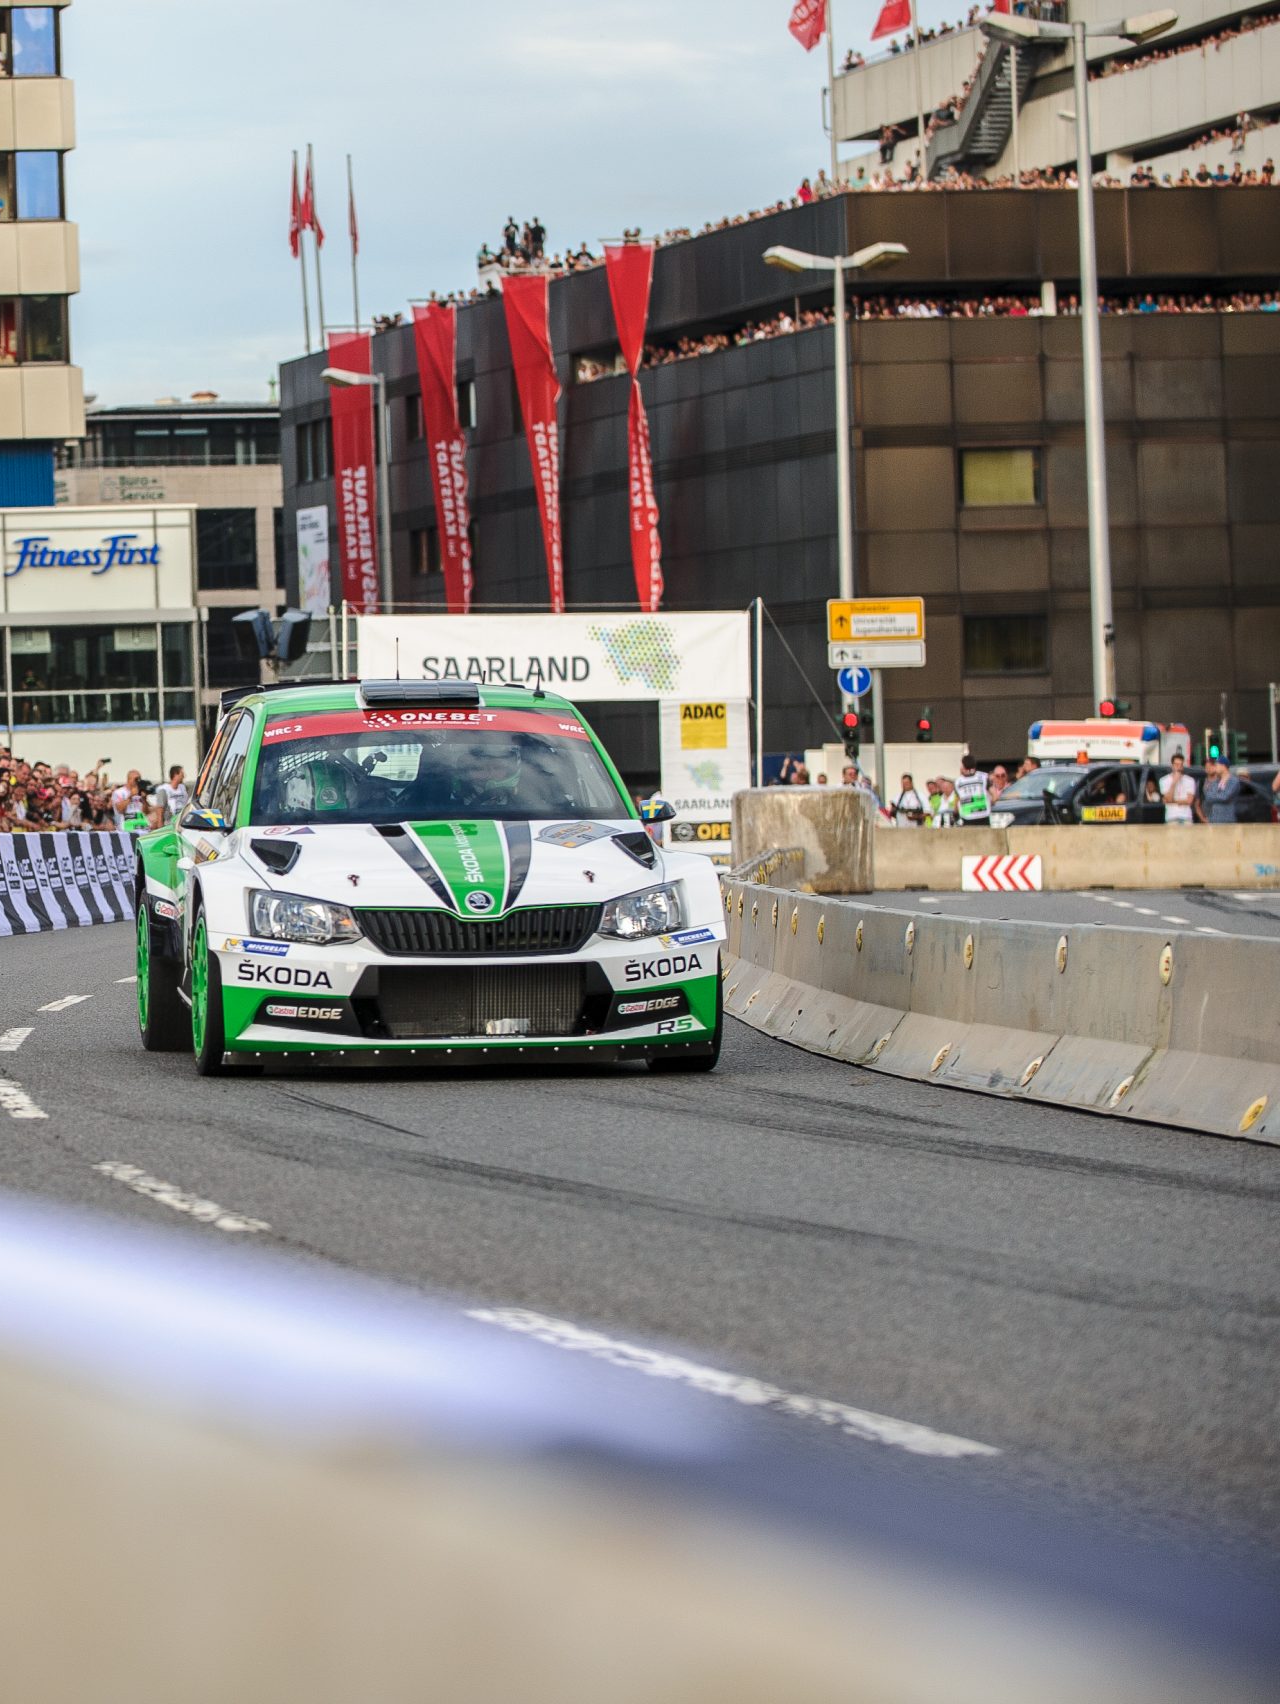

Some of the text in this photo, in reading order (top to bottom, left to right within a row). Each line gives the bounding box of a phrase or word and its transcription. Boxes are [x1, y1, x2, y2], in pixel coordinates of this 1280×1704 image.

[423, 656, 590, 682] SAARLAND
[400, 712, 497, 722] ONEBET
[682, 703, 726, 721] ADAC
[264, 724, 303, 738] WRC 2
[674, 798, 732, 810] SAARLAN
[696, 822, 731, 840] OPE
[461, 849, 484, 884] ŠKODA
[246, 943, 289, 953] MICHELIN
[238, 959, 333, 989] ŠKODA
[624, 953, 703, 983] ŠKODA
[272, 1006, 344, 1020] Castrol EDGE
[646, 996, 681, 1012] EDGE
[657, 1017, 694, 1035] R5
